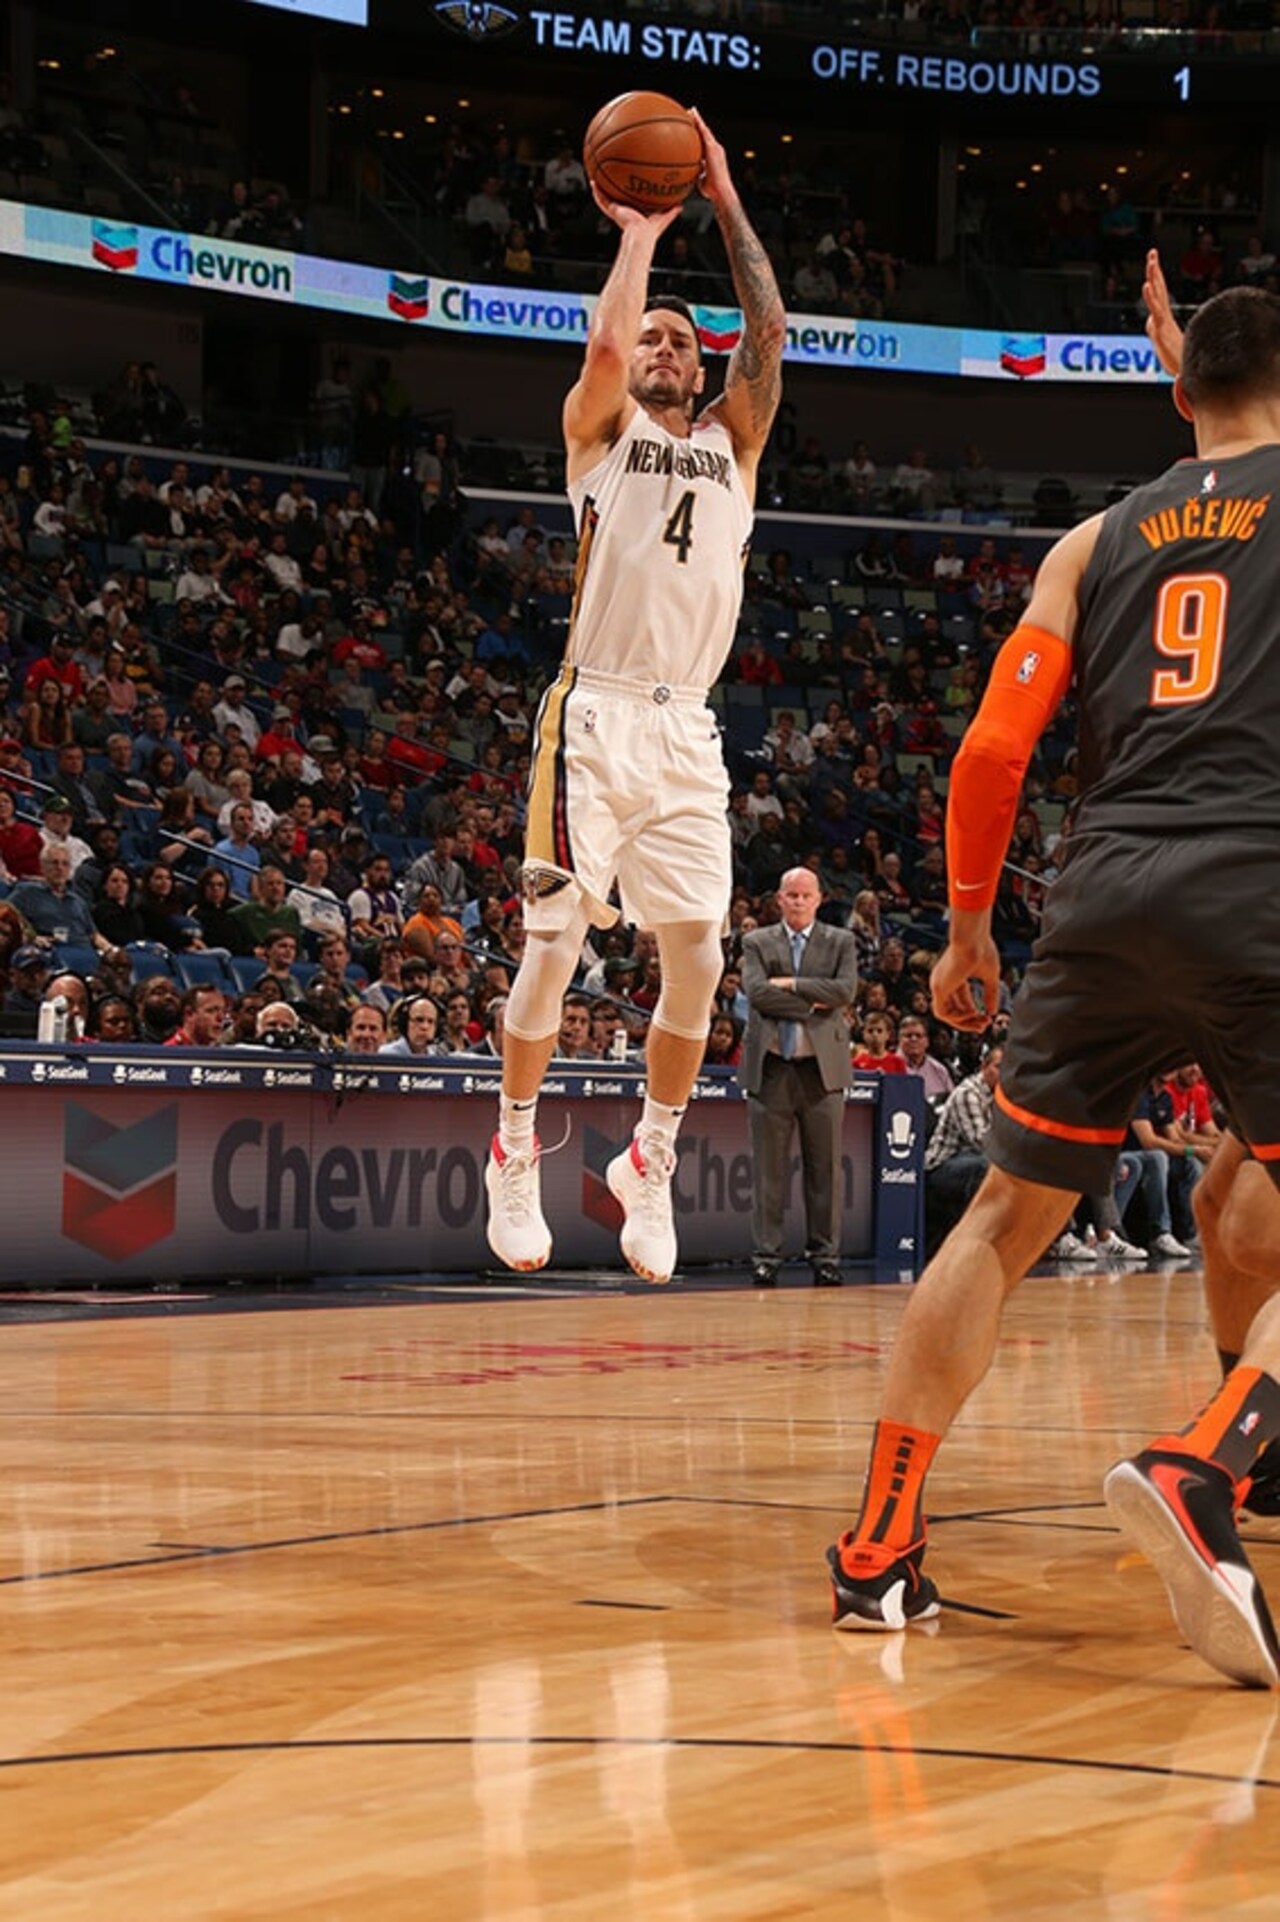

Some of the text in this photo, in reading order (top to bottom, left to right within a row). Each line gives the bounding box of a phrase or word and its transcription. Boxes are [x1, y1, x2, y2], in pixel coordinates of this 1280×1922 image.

[530, 11, 1190, 100] TEAM STATS: OFF. REBOUNDS 1
[151, 236, 290, 292] Chevron
[440, 286, 588, 331] Chevron
[1060, 340, 1161, 373] Chev
[624, 438, 674, 476] NEW
[663, 489, 697, 564] 4
[1139, 494, 1271, 550] VUČEVIĆ
[1150, 572, 1231, 710] 9
[48, 1064, 89, 1080] SeatGeek
[128, 1067, 167, 1081] SeatGeek
[204, 1069, 242, 1083] SeatGeek
[277, 1071, 312, 1085] SeatGeek
[411, 1076, 444, 1089] SeatGeek
[594, 1081, 623, 1094] SeatGeek
[212, 1118, 488, 1234] Chevro
[881, 1167, 917, 1183] SeatGeek
